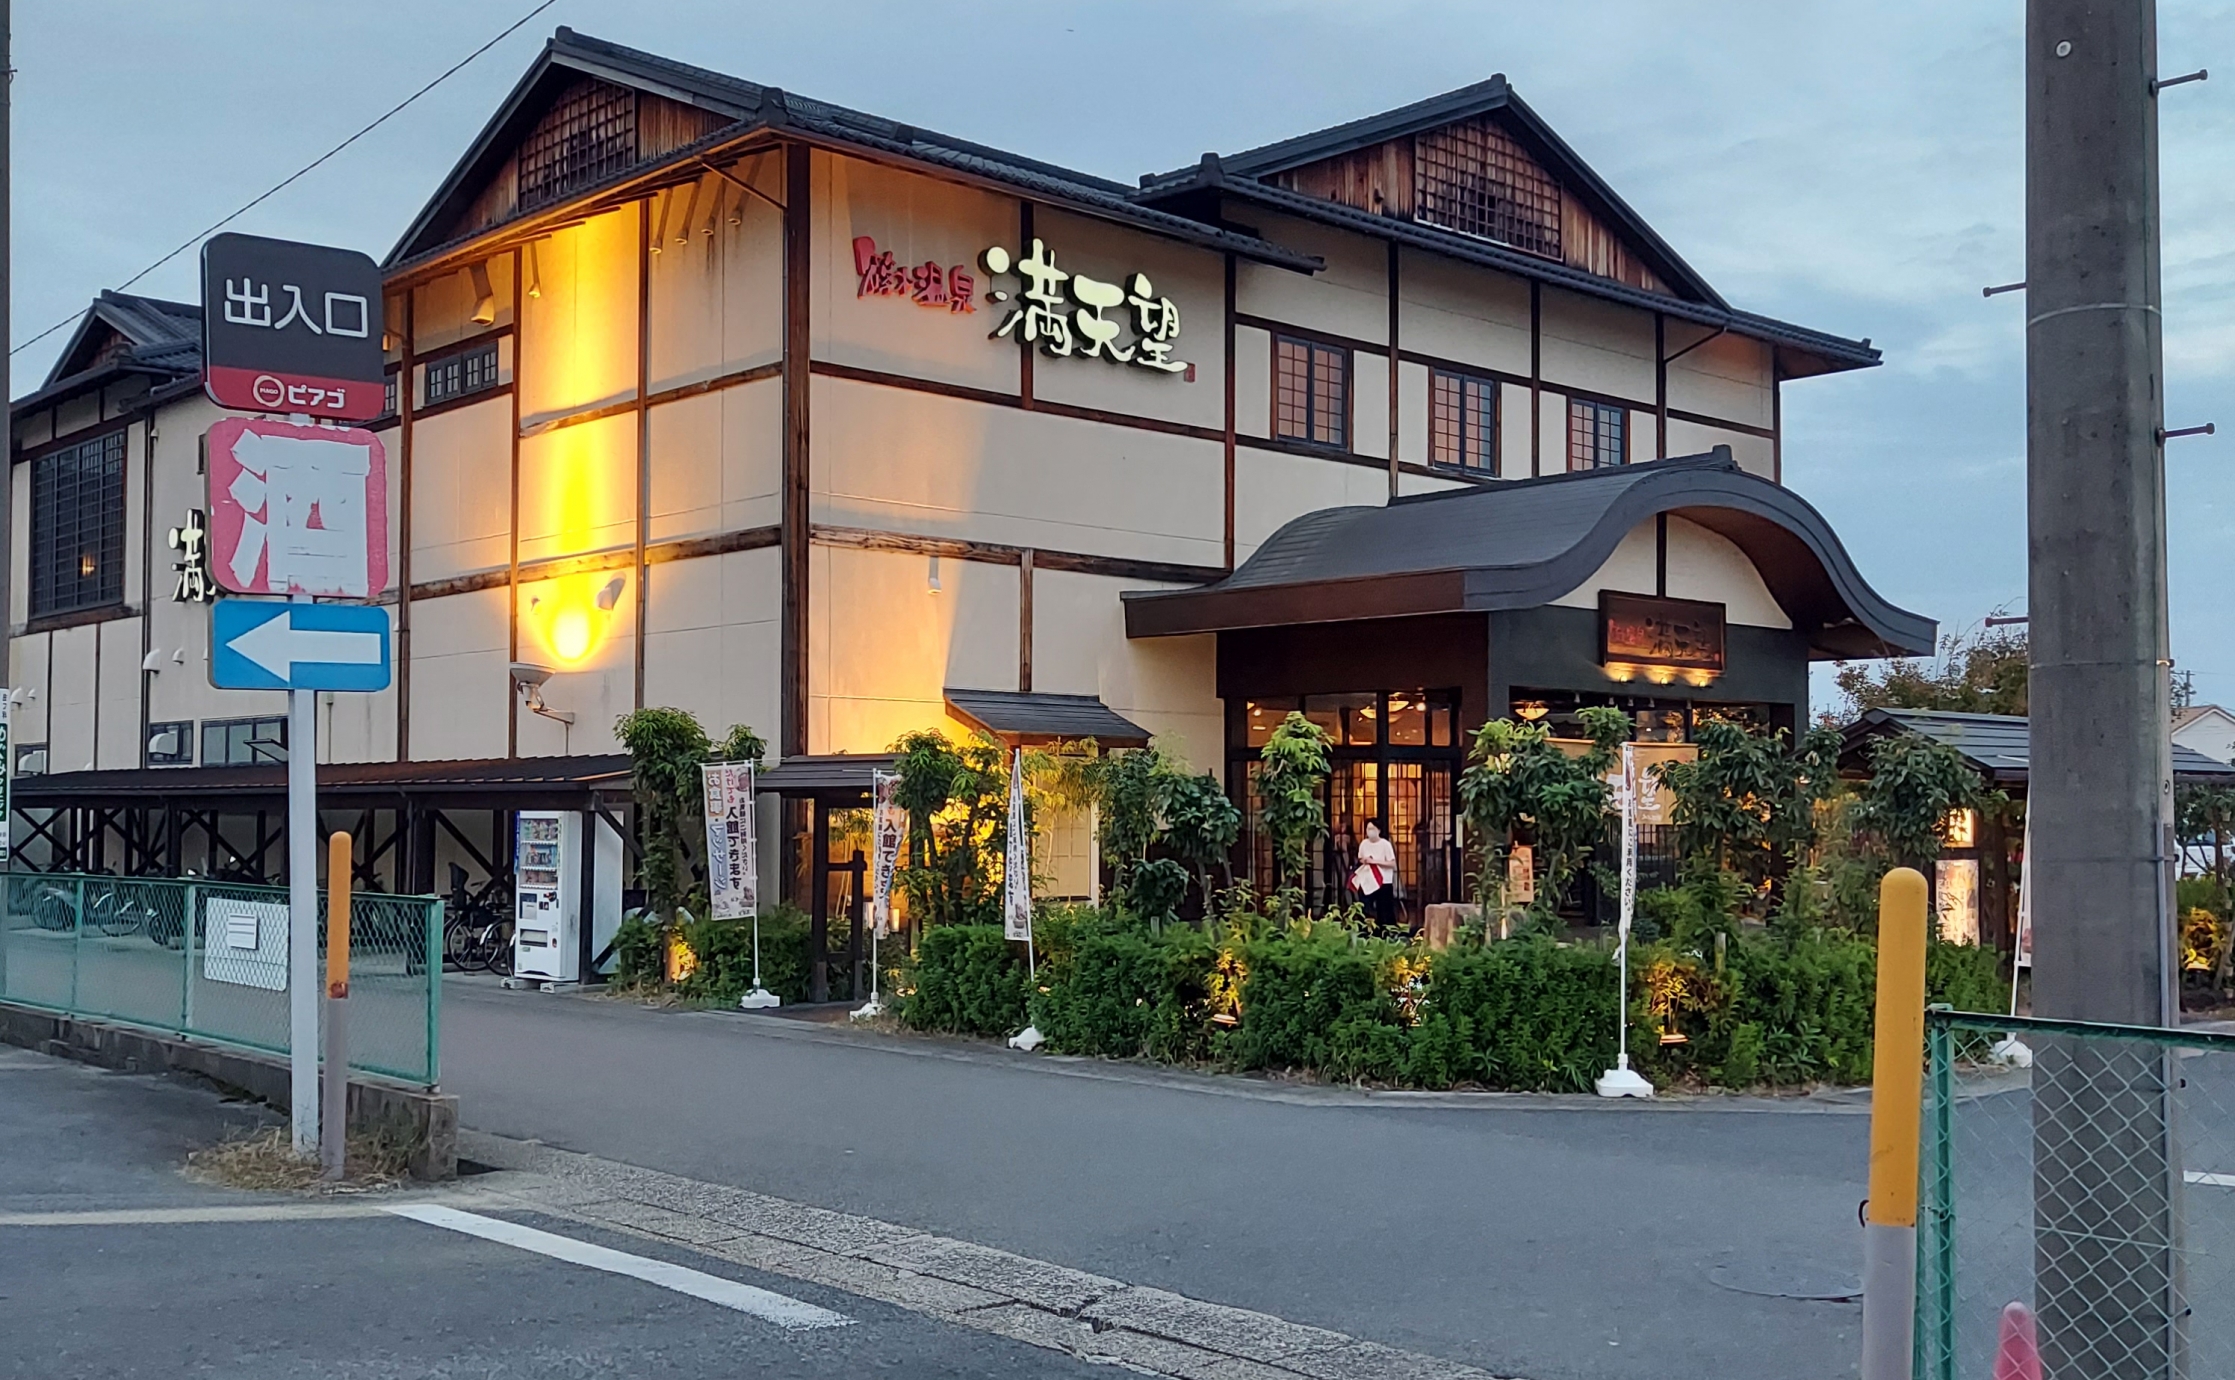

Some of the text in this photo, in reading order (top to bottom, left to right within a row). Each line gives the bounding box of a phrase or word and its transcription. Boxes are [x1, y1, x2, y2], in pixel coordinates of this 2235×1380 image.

[224, 277, 368, 338] 出入口
[984, 238, 1188, 372] 満天望
[288, 384, 346, 408] ピアゴ
